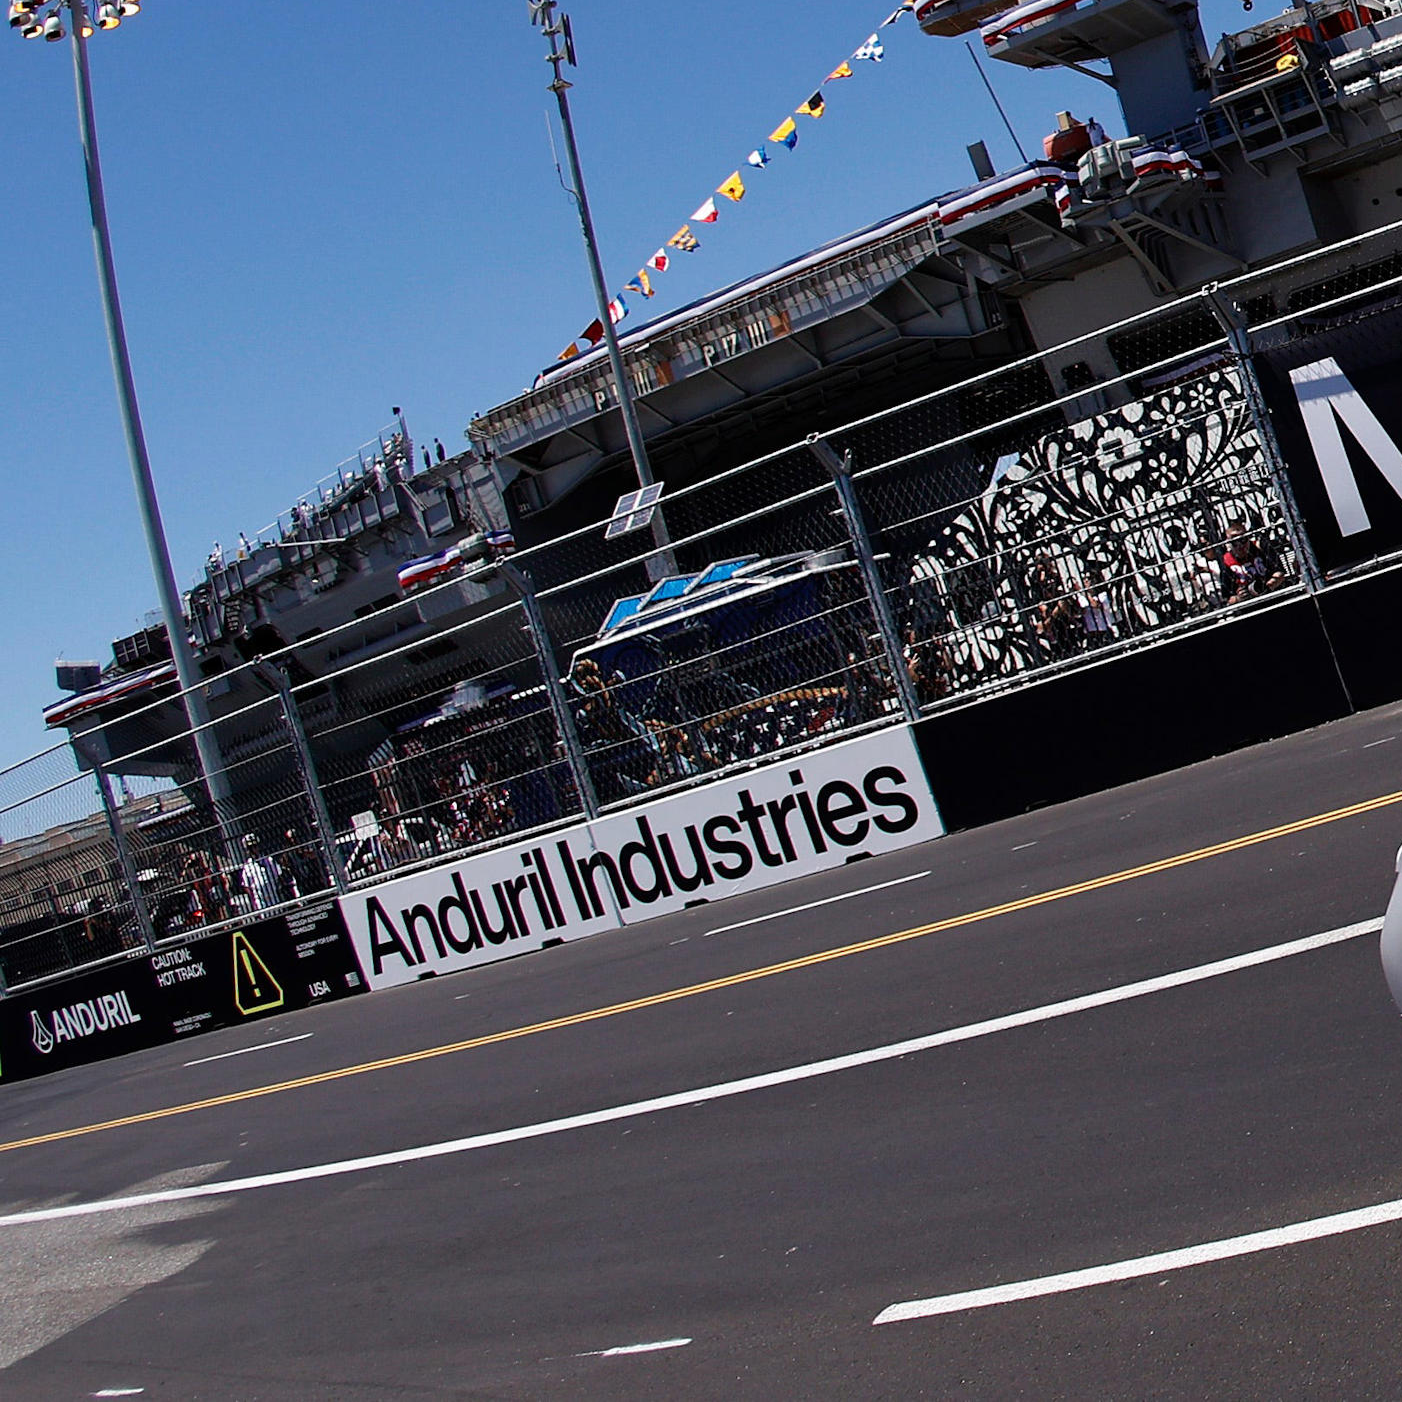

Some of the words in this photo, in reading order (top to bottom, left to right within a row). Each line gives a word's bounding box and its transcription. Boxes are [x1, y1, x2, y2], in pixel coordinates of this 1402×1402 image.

[366, 847, 564, 976] Anduril
[563, 764, 921, 925] Industries
[157, 970, 175, 988] HOT
[175, 962, 206, 981] TRACK
[309, 980, 331, 997] USA
[53, 989, 141, 1044] ANDURIL
